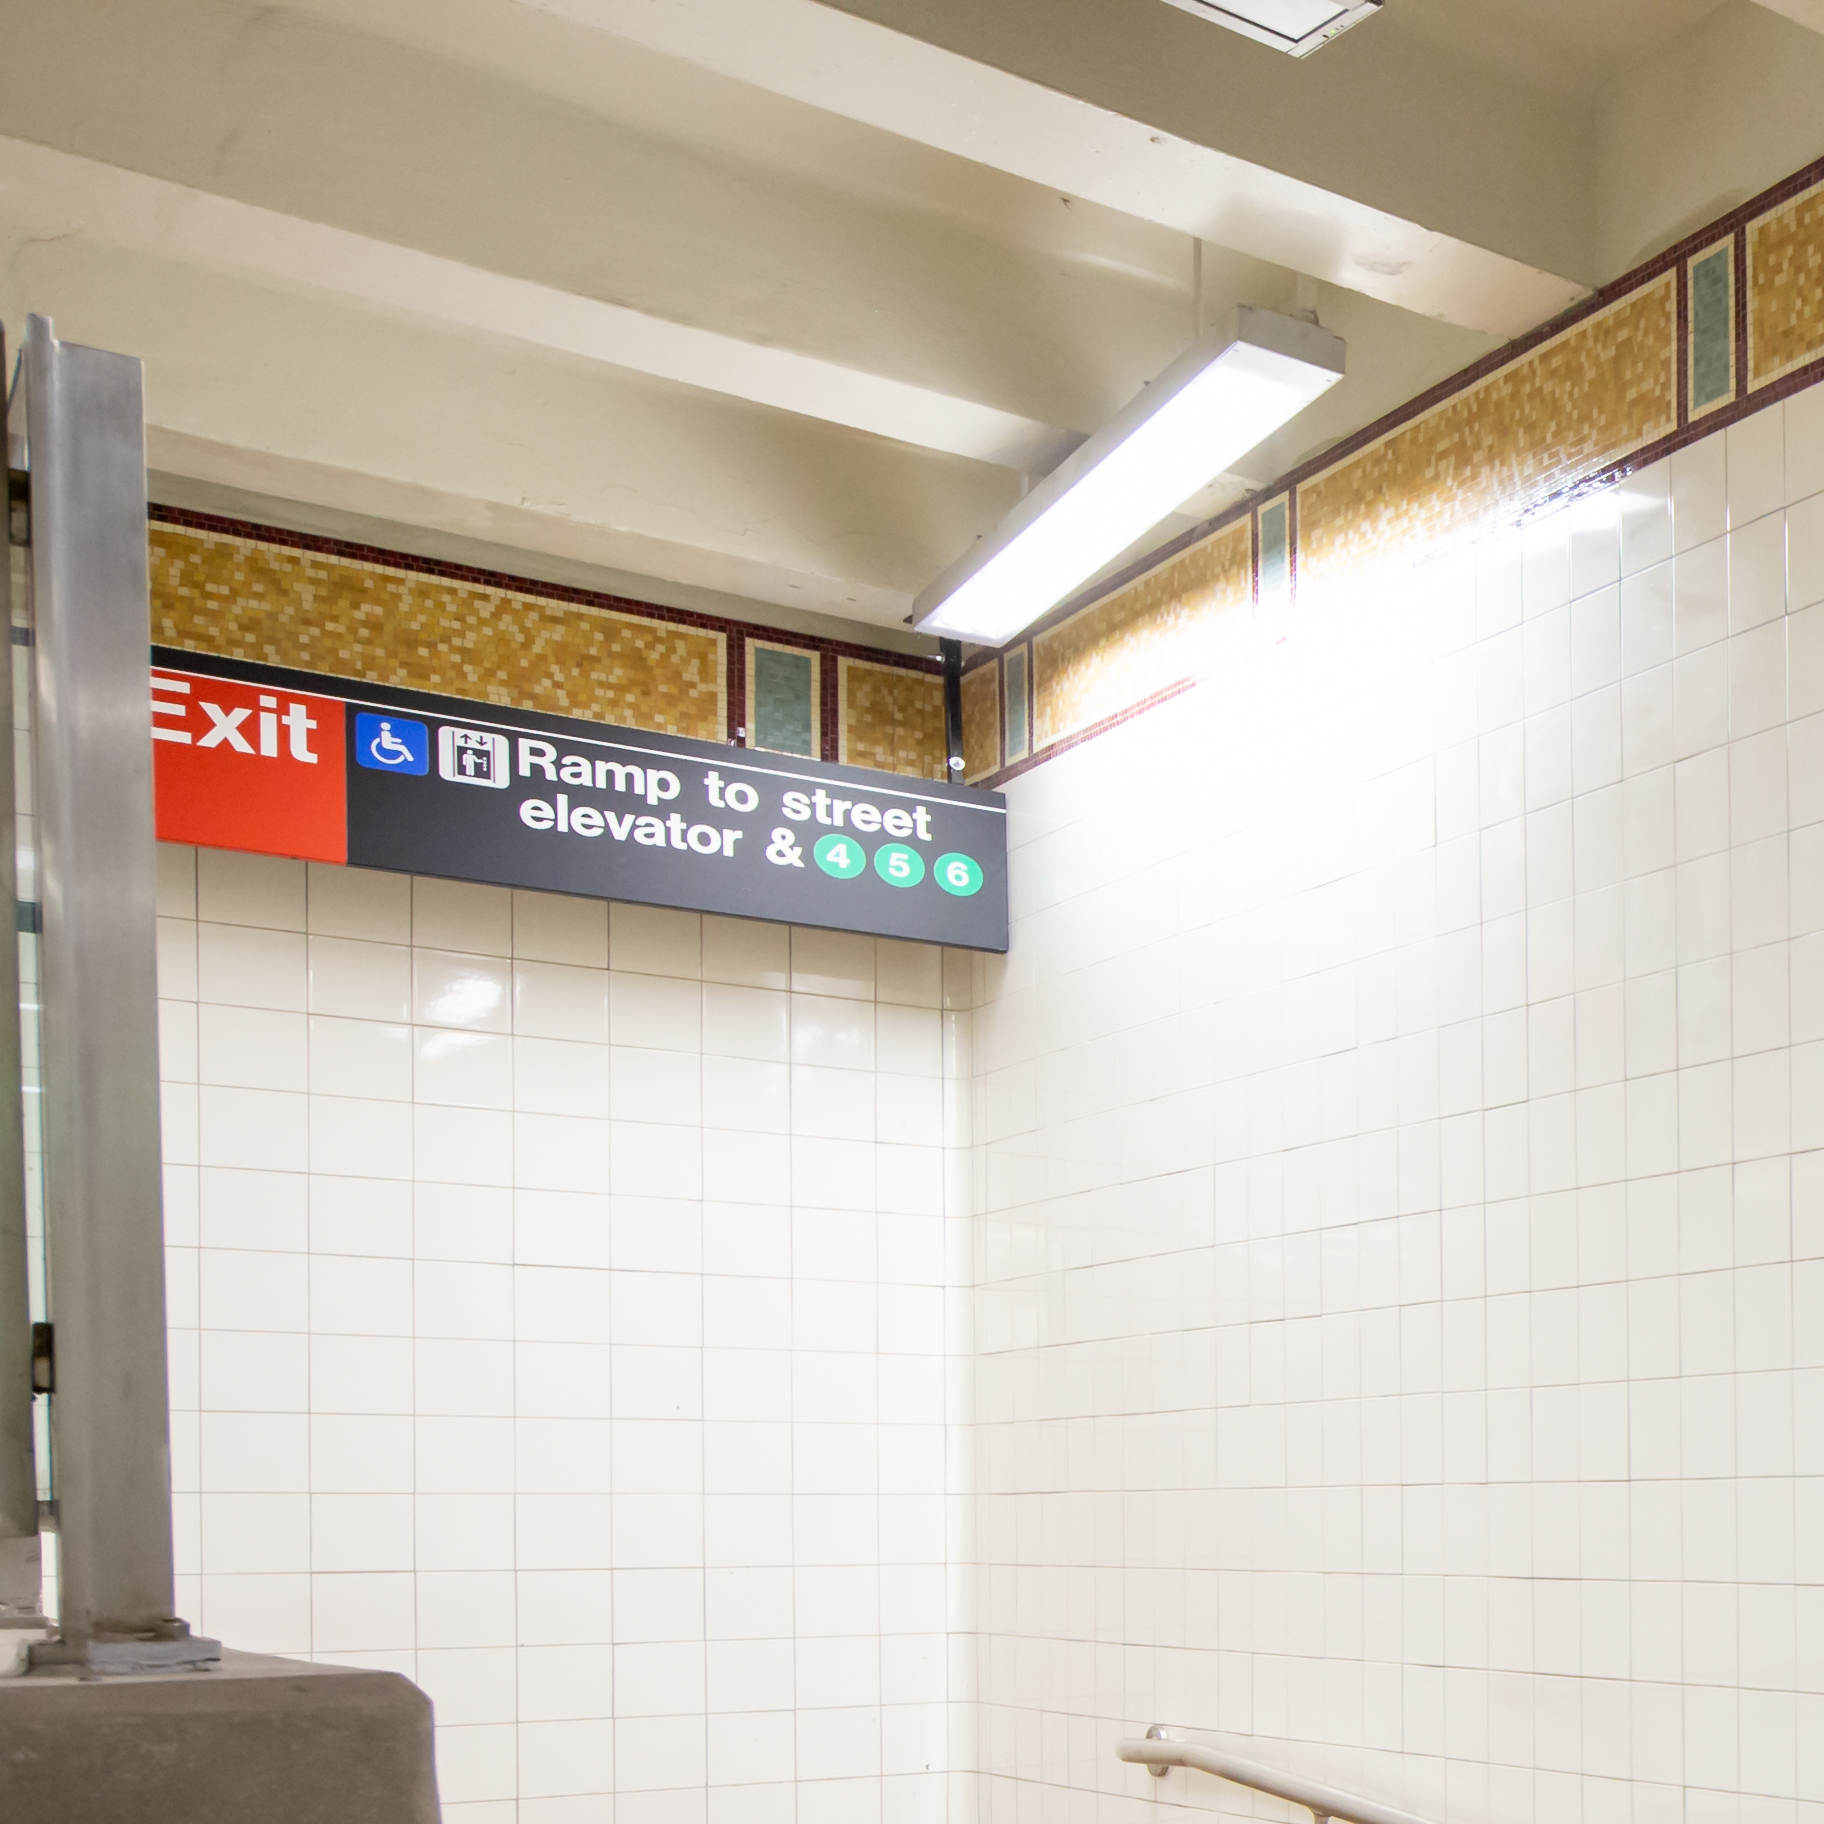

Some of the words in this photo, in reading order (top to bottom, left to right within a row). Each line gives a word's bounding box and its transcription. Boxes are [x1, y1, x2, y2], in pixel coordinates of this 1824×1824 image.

[150, 675, 318, 764] Exit
[518, 737, 682, 806] Ramp
[704, 771, 760, 813] to
[782, 788, 933, 842] street
[519, 793, 743, 858] elevator
[765, 827, 805, 869] &
[825, 841, 851, 870] 4
[887, 850, 912, 878] 5
[946, 859, 970, 888] 6
